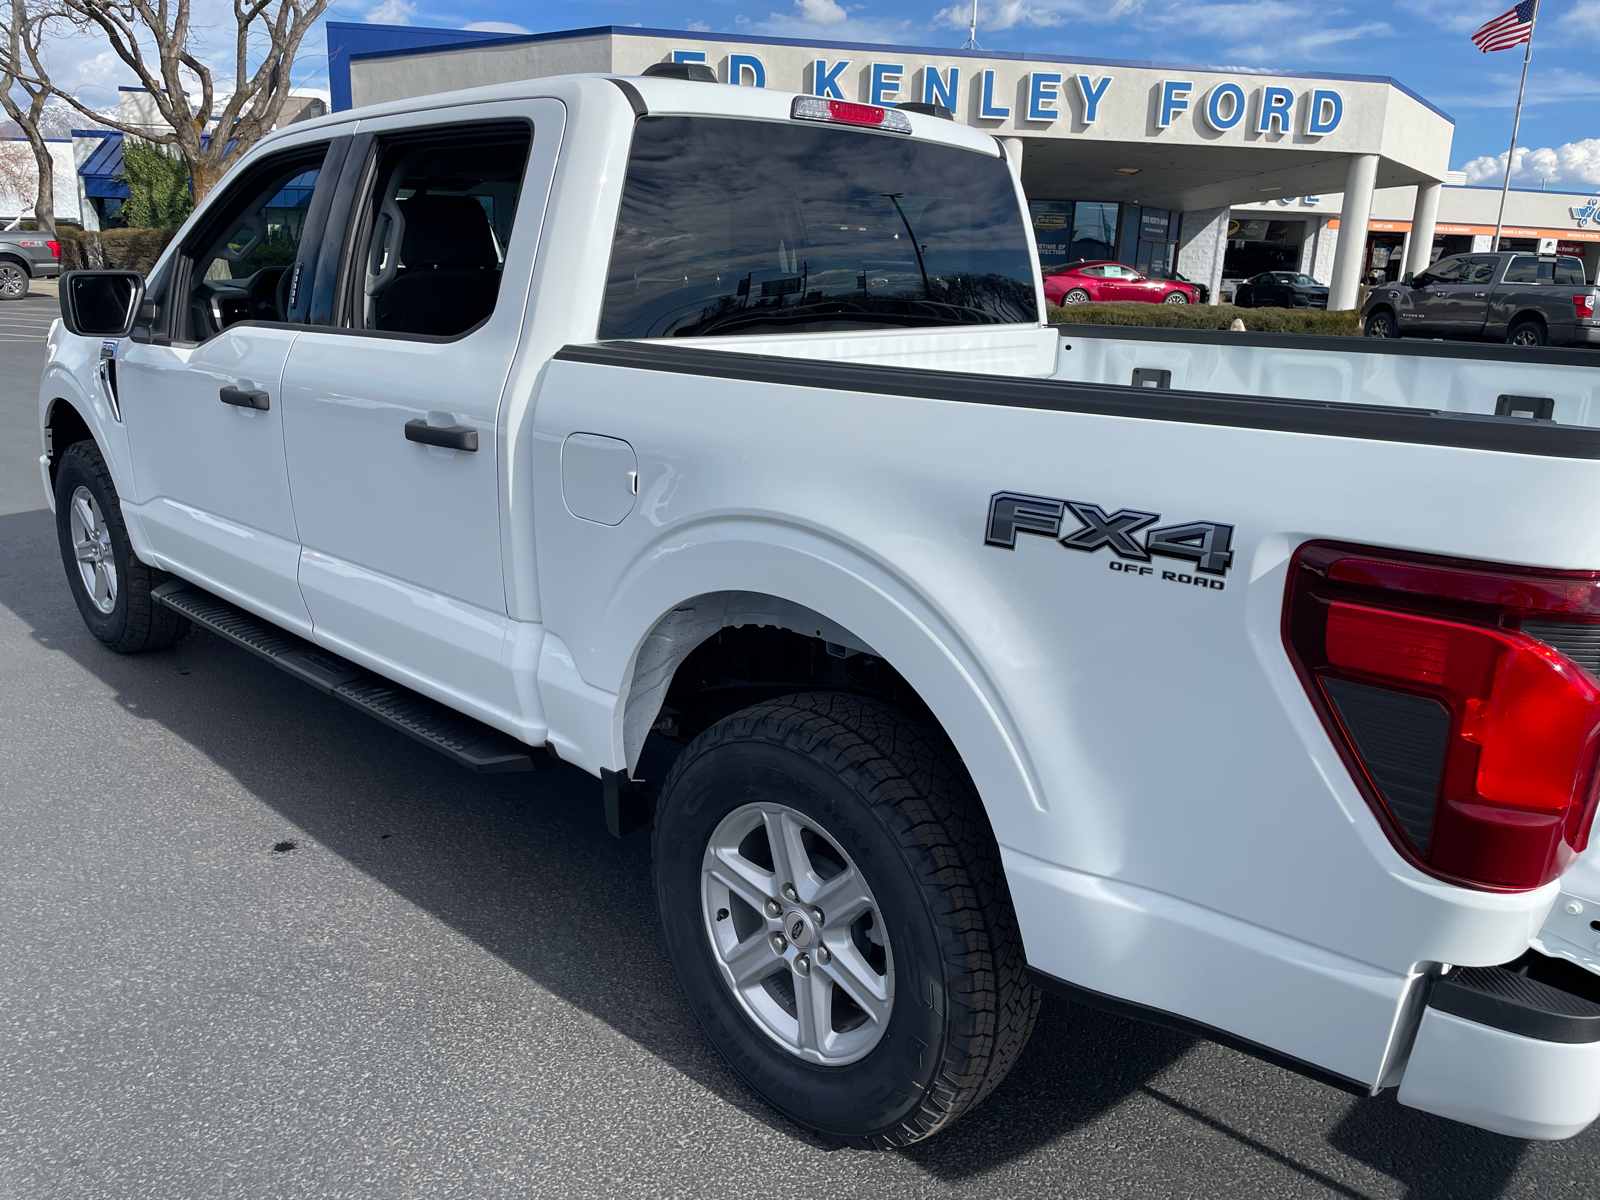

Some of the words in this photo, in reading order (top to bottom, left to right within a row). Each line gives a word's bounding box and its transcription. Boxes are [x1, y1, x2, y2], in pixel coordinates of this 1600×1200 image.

[671, 49, 767, 88] D
[813, 59, 1115, 124] KENLEY
[1156, 79, 1345, 137] FORD
[983, 490, 1236, 577] FX4
[1108, 561, 1154, 576] OFF
[1161, 570, 1226, 591] ROAD
